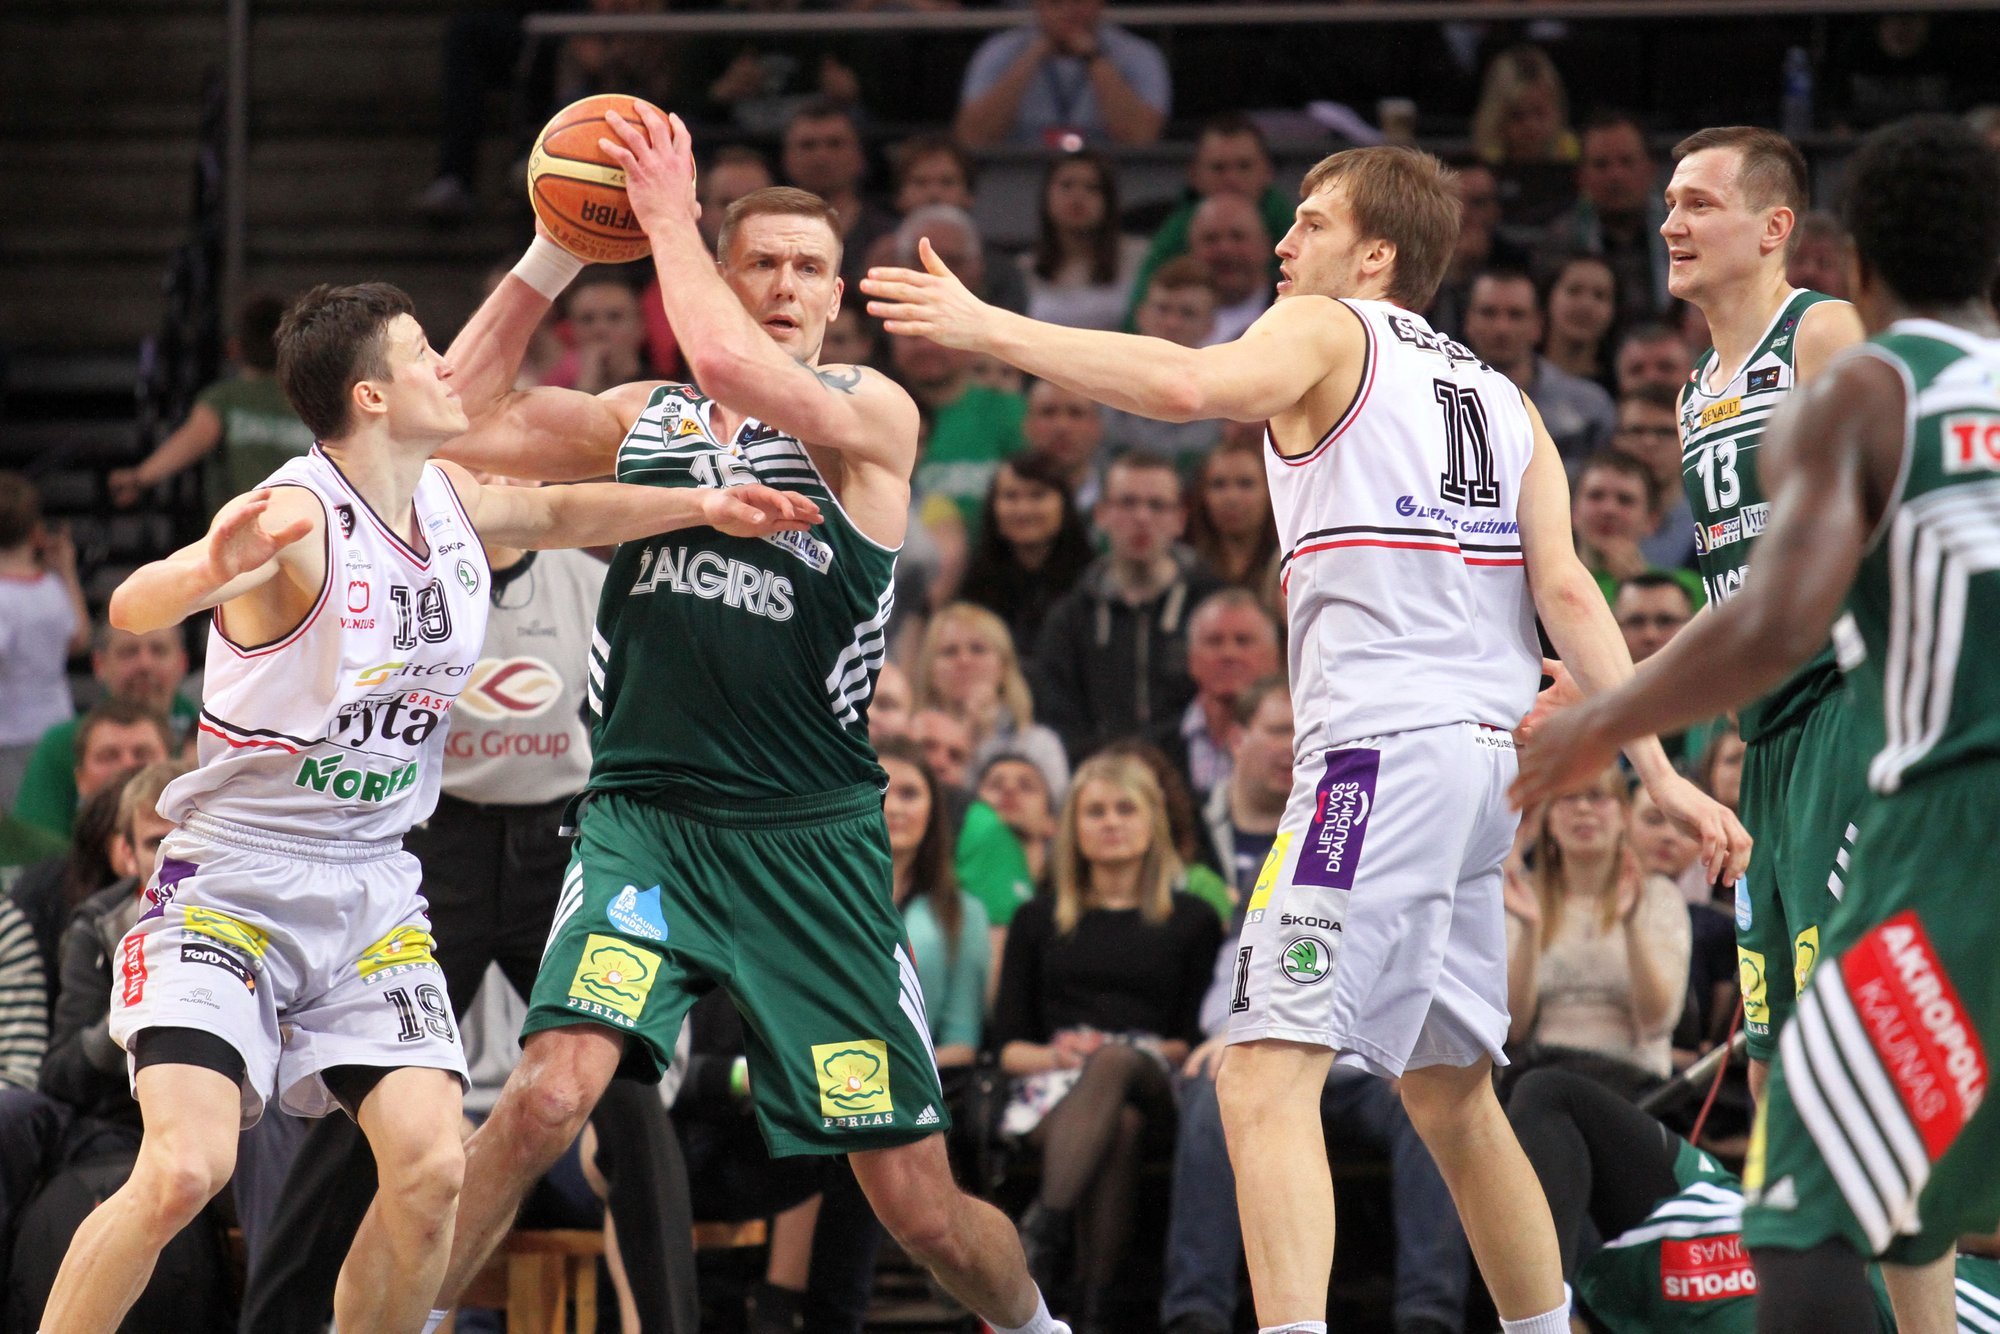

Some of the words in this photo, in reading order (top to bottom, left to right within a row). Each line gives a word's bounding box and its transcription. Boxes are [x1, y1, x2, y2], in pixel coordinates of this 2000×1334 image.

[581, 200, 631, 230] FIBA
[1702, 401, 1739, 424] RENAULT
[1433, 378, 1500, 508] 11
[1696, 439, 1741, 513] 13
[438, 541, 466, 557] ŠKA
[390, 577, 453, 651] 19
[444, 731, 473, 759] G
[480, 730, 571, 759] Group
[1316, 782, 1346, 855] LIETUVOS
[1326, 781, 1360, 873] DRAUDIMAS
[630, 911, 662, 938] KAUNO
[1280, 912, 1343, 933] ŠKODA
[383, 983, 455, 1044] 19
[567, 997, 636, 1028] PERLAS
[1858, 976, 1947, 1123] KAUNAS
[824, 1112, 894, 1128] PERLAS
[915, 1116, 940, 1126] adidas
